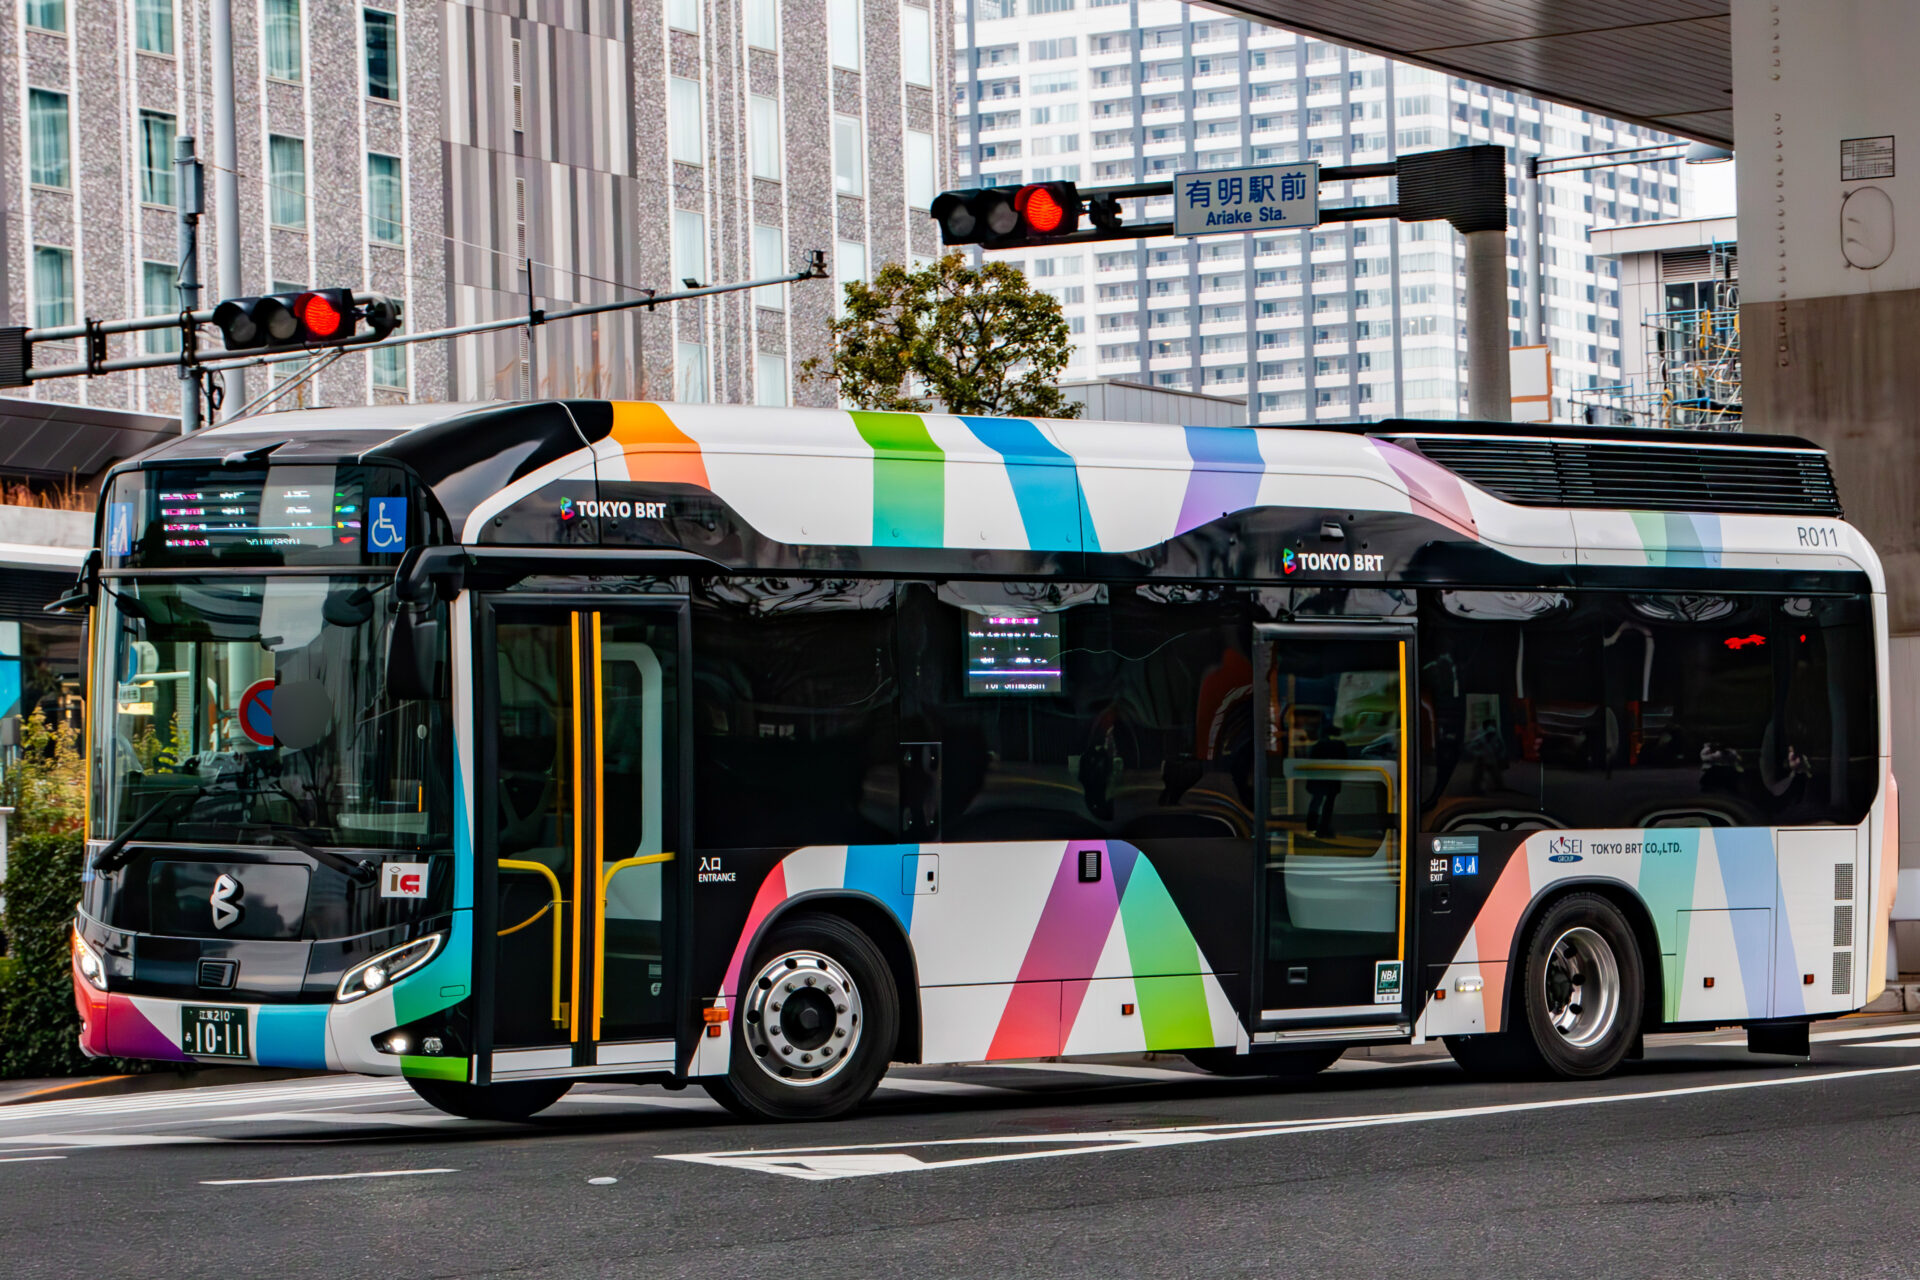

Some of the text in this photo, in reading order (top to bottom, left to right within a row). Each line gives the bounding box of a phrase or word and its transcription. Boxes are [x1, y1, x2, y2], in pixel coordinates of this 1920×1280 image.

[1185, 171, 1307, 208] 有明駅前
[1206, 206, 1287, 226] Ariake Sta.
[576, 500, 631, 518] TOKYO
[634, 502, 667, 519] BRT
[1797, 526, 1838, 547] R011
[1298, 552, 1351, 571] TOKYO
[1353, 554, 1384, 571] BRT
[1591, 843, 1622, 855] TOKYO
[1625, 843, 1643, 854] BRT
[699, 856, 721, 871] 入口
[1430, 858, 1448, 872] 出口
[698, 872, 736, 883] ENTRANCE
[1429, 873, 1444, 882] EXIT
